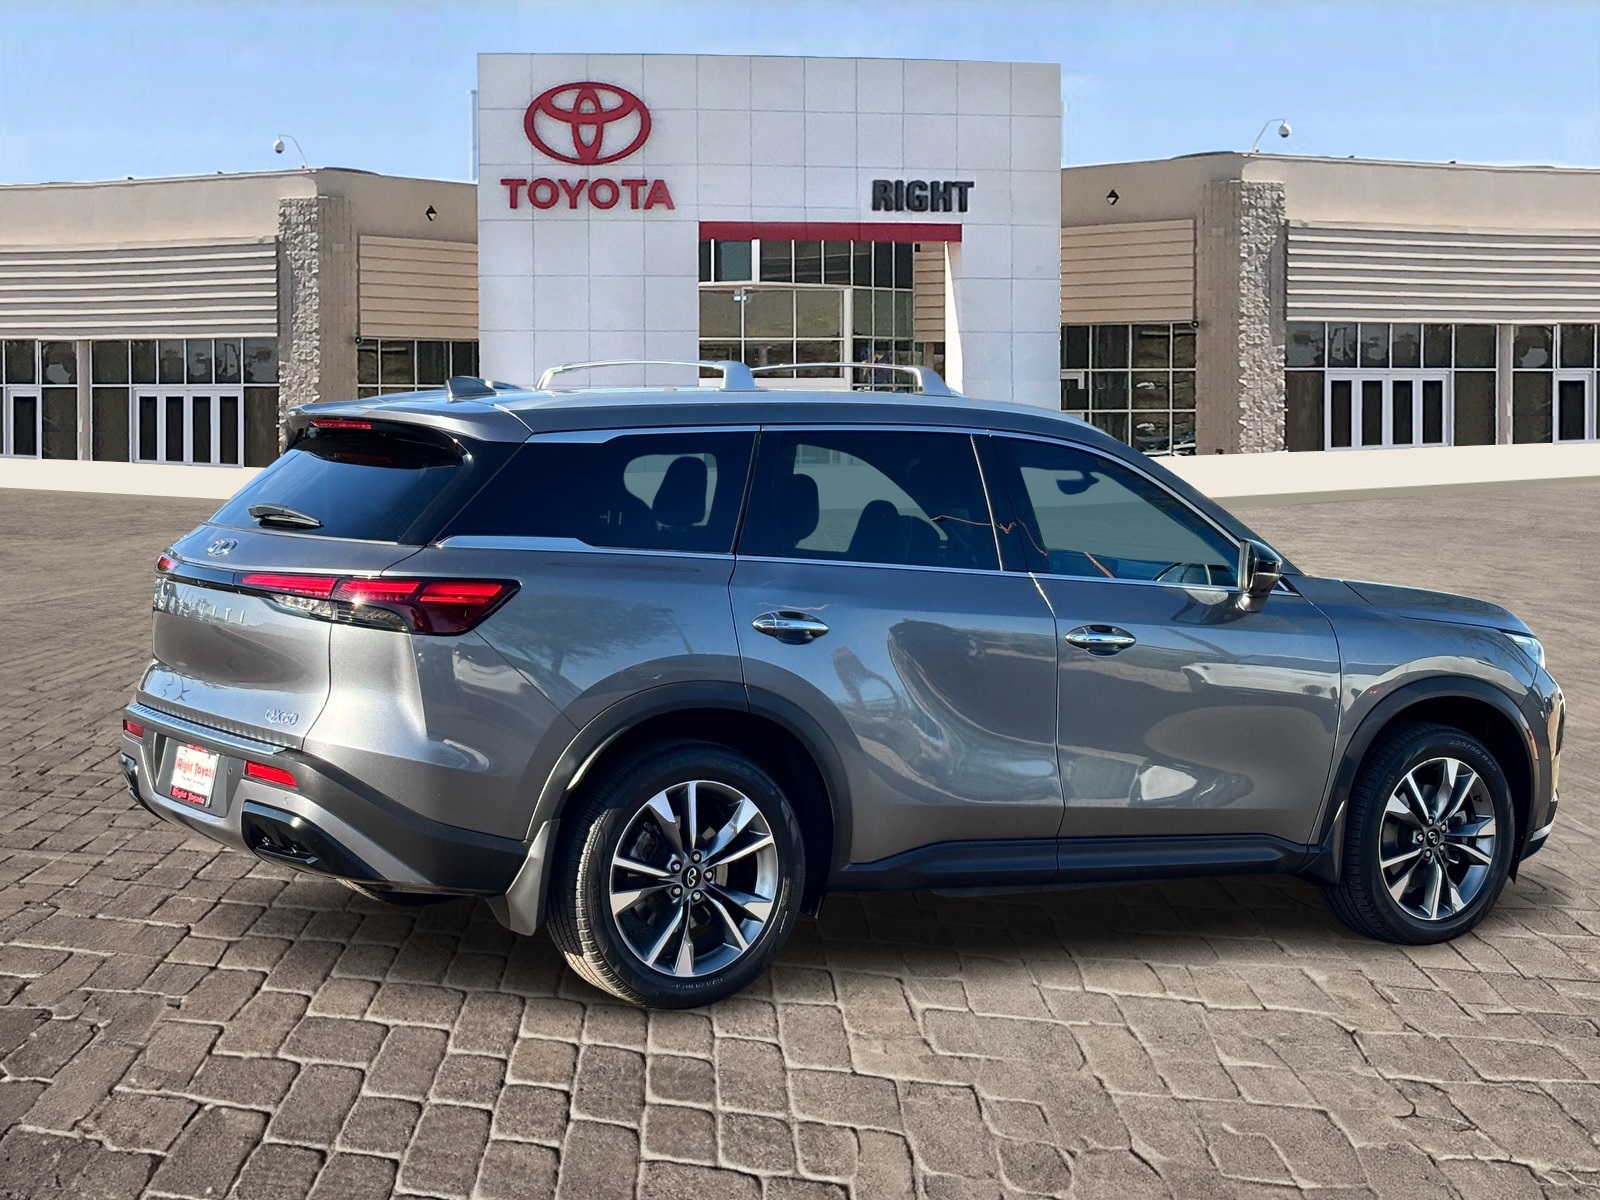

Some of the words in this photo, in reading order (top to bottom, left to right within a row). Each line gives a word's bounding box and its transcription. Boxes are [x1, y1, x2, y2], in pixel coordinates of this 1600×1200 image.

[500, 178, 676, 210] TOYOTA
[871, 179, 976, 213] RIGHT
[264, 707, 299, 726] QX60
[177, 758, 193, 774] Right
